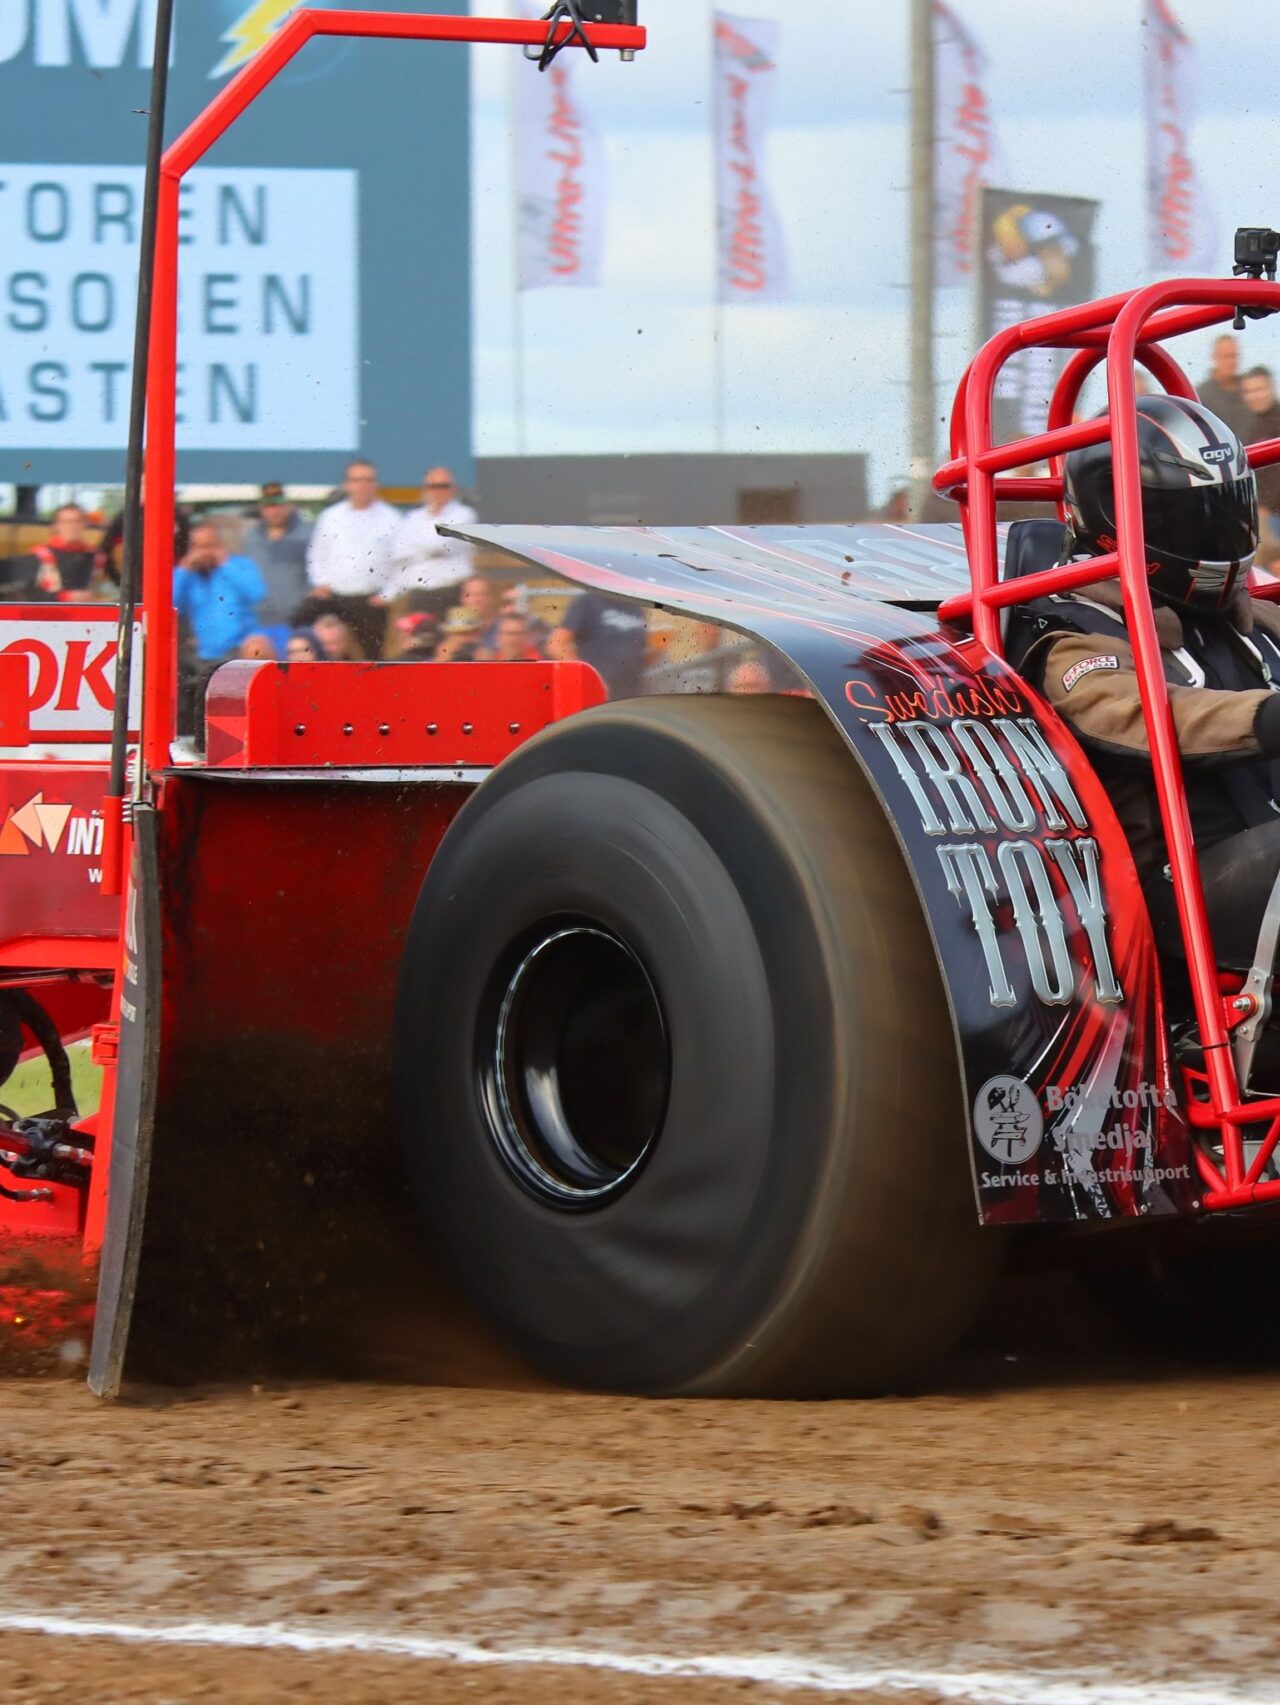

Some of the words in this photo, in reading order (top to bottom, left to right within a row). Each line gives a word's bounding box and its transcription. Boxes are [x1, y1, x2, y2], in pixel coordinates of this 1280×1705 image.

[1202, 446, 1232, 462] agv
[844, 674, 1022, 723] Swedish
[867, 717, 1088, 836] IRON
[935, 837, 1125, 1008] TOY
[981, 1170, 1040, 1188] Service
[1044, 1169, 1058, 1185] &
